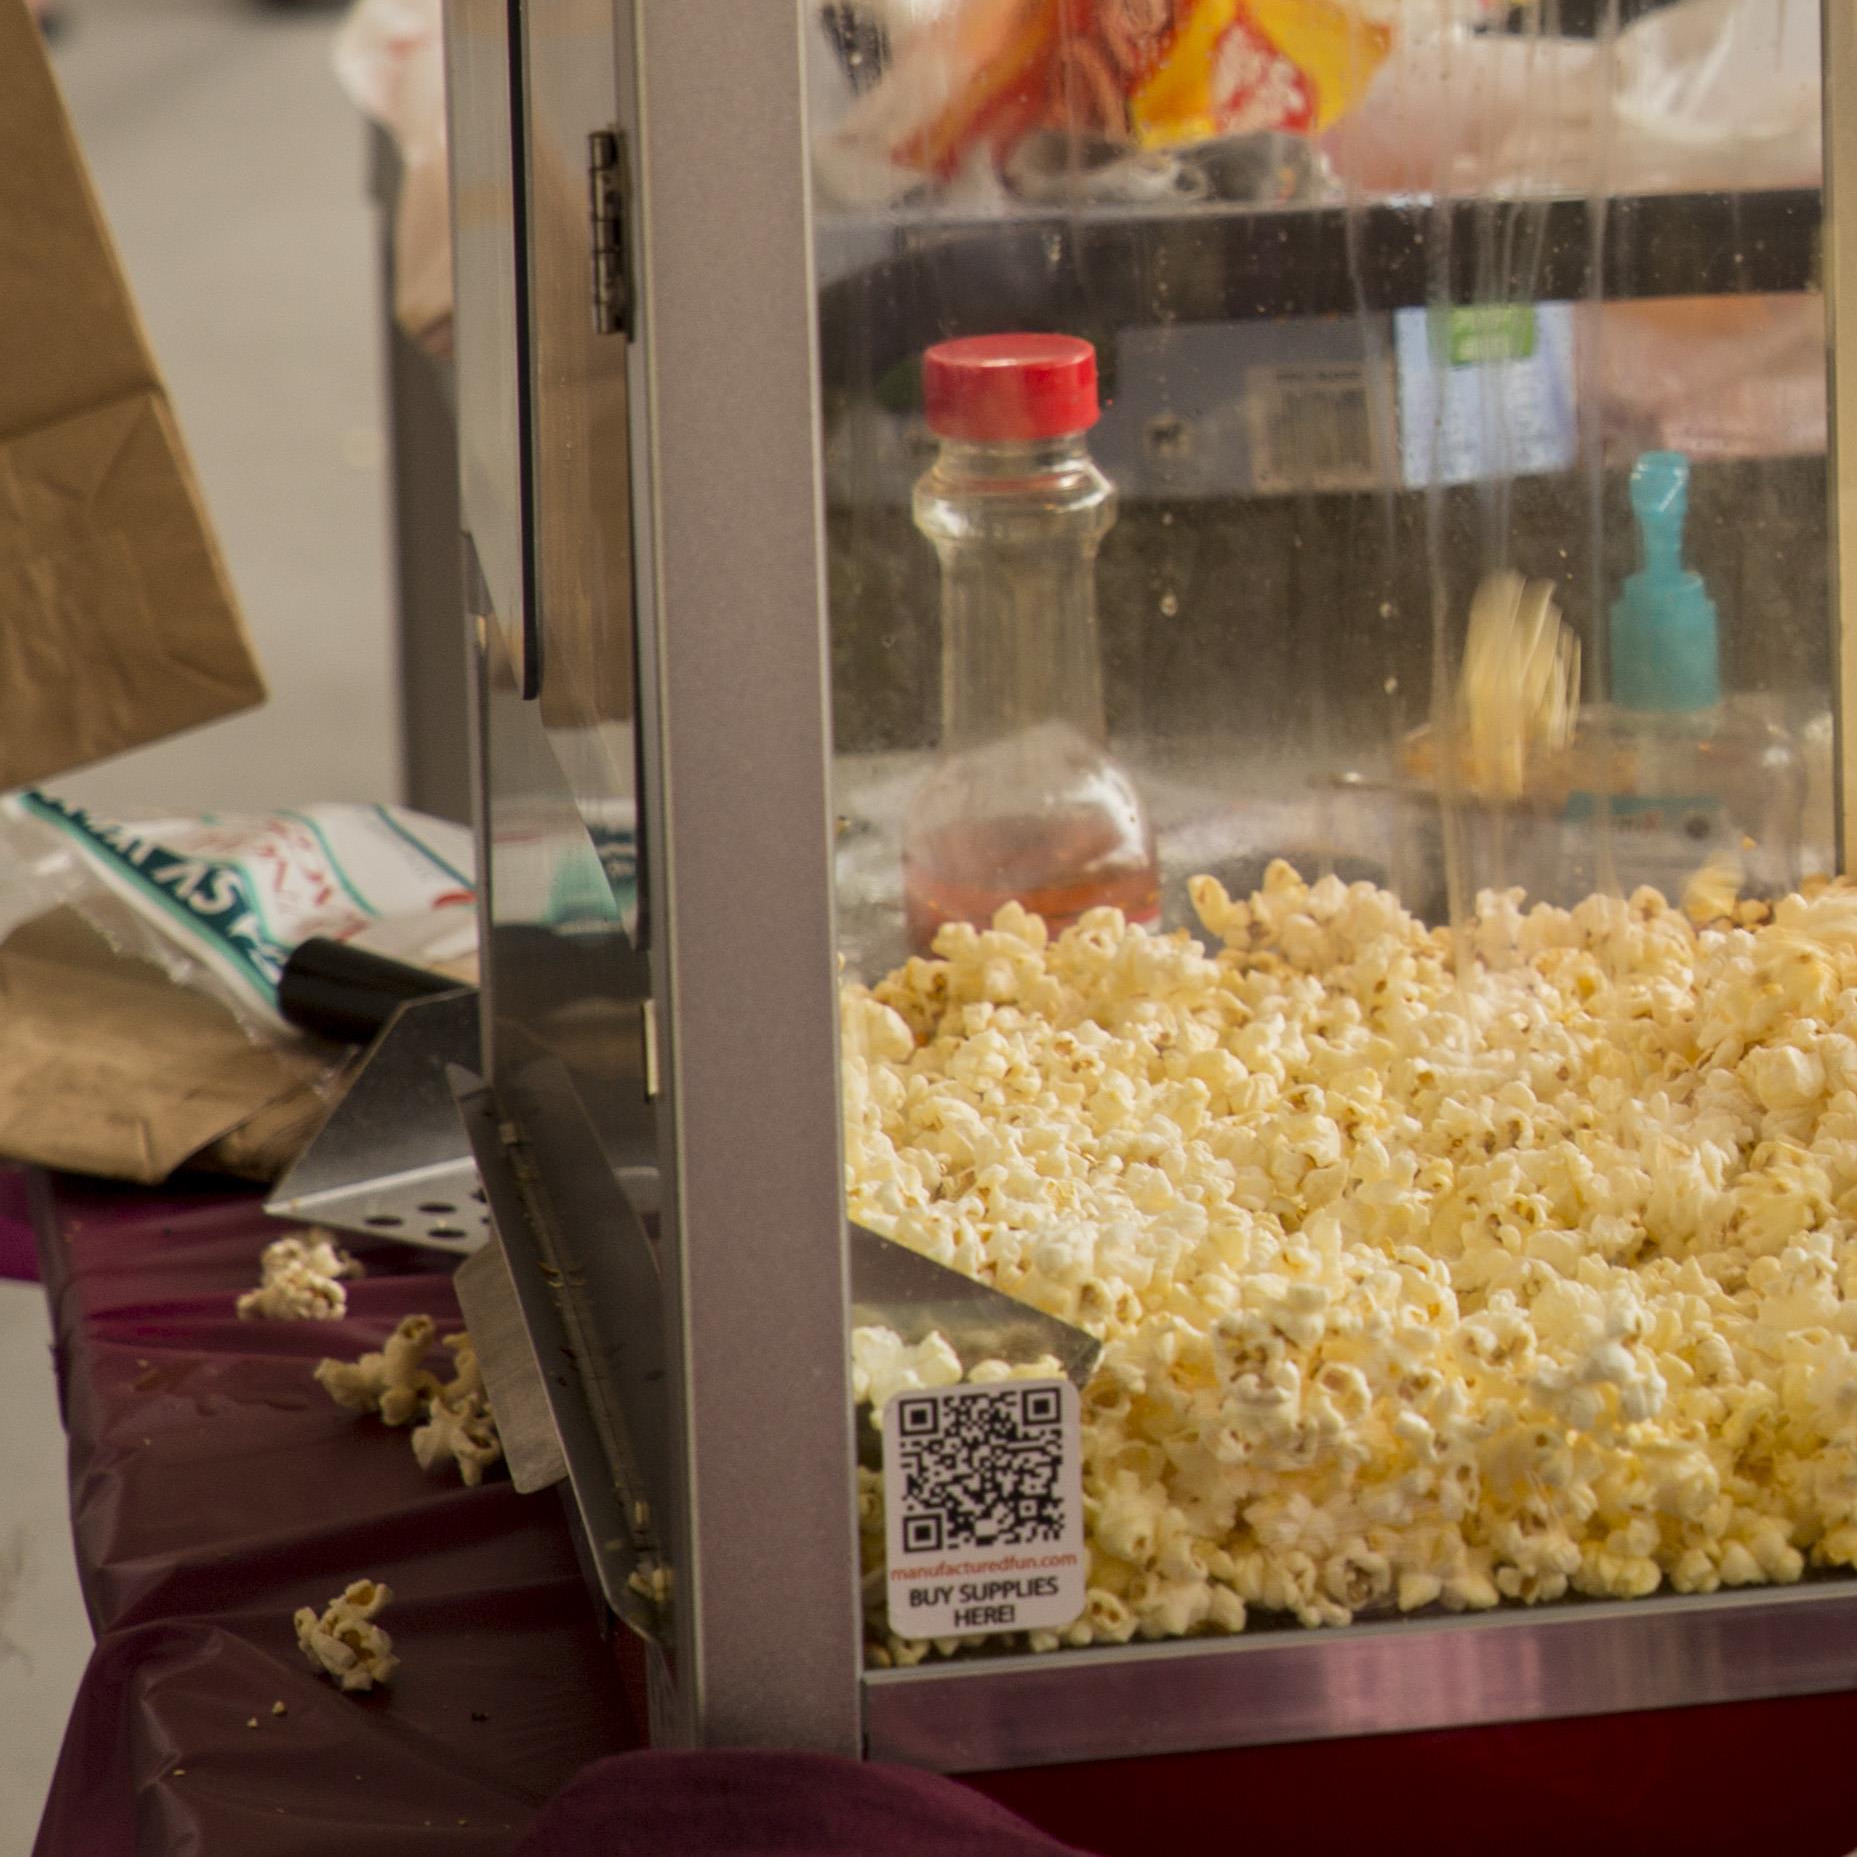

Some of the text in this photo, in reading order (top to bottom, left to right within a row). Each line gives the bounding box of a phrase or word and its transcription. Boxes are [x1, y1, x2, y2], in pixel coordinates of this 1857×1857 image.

[891, 1553, 1077, 1582] manufacturedfun.com
[909, 1576, 1059, 1608] BUY SUPPLIES
[953, 1604, 1016, 1628] HERE!
